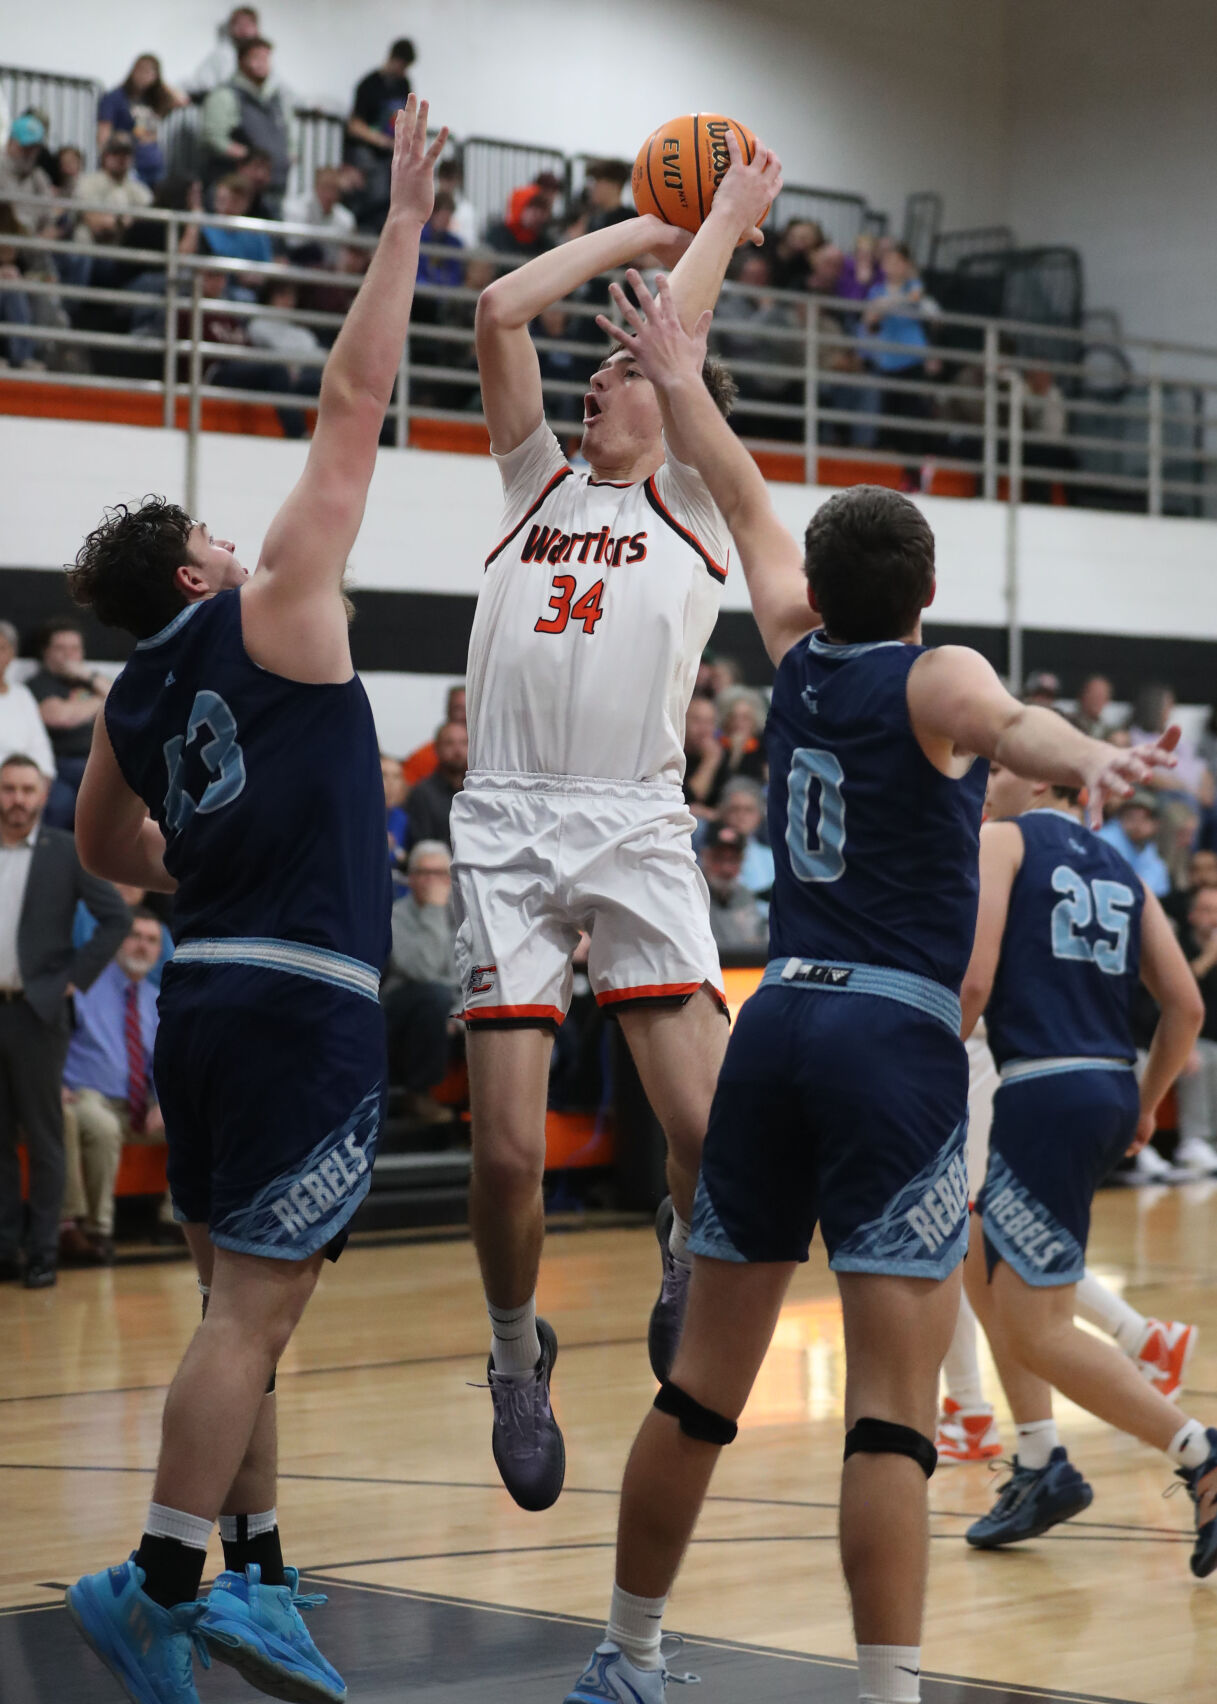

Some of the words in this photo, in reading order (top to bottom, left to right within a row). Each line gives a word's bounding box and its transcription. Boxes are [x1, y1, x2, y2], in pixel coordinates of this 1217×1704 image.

[662, 138, 683, 190] EVO
[521, 524, 648, 568] Warriors
[534, 575, 604, 634] 34
[785, 747, 846, 882] 0
[1051, 865, 1135, 975] 25
[271, 1132, 369, 1240] REBELS
[987, 1187, 1065, 1267] REBELS
